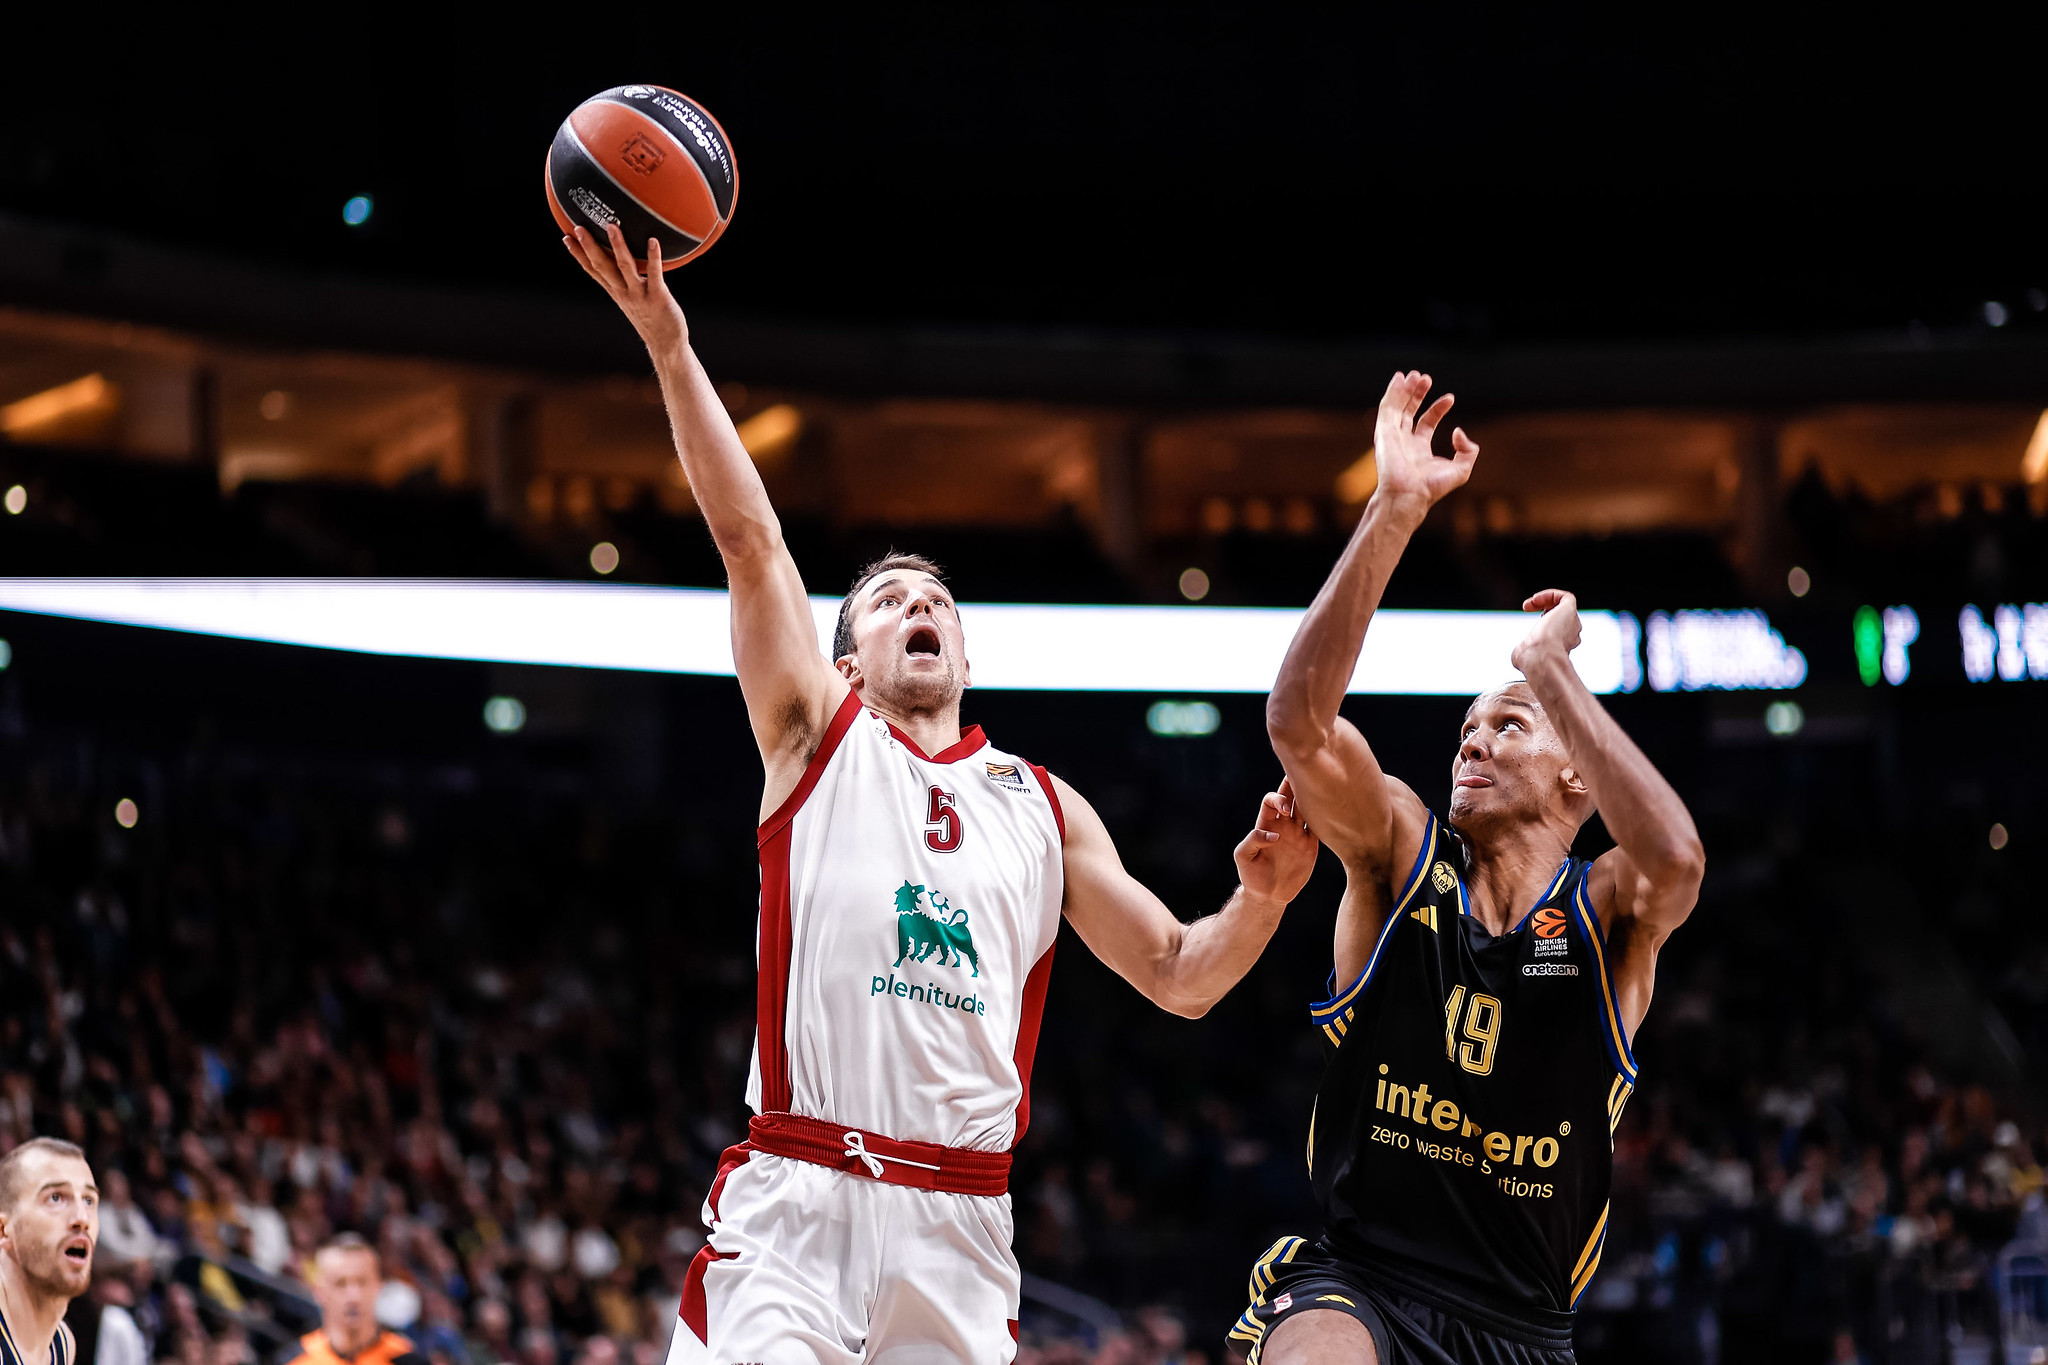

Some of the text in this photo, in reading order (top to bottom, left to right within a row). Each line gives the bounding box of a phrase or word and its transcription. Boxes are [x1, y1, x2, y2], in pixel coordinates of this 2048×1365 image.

[662, 92, 731, 183] TURKISH AIRLINES
[924, 784, 964, 854] 5
[1522, 962, 1579, 976] oneteam
[1534, 937, 1568, 946] TURKISH
[1534, 944, 1568, 952] AIRLINES
[871, 973, 985, 1017] plenitude
[1445, 984, 1502, 1076] 19
[1370, 1124, 1554, 1199] zero waste stions
